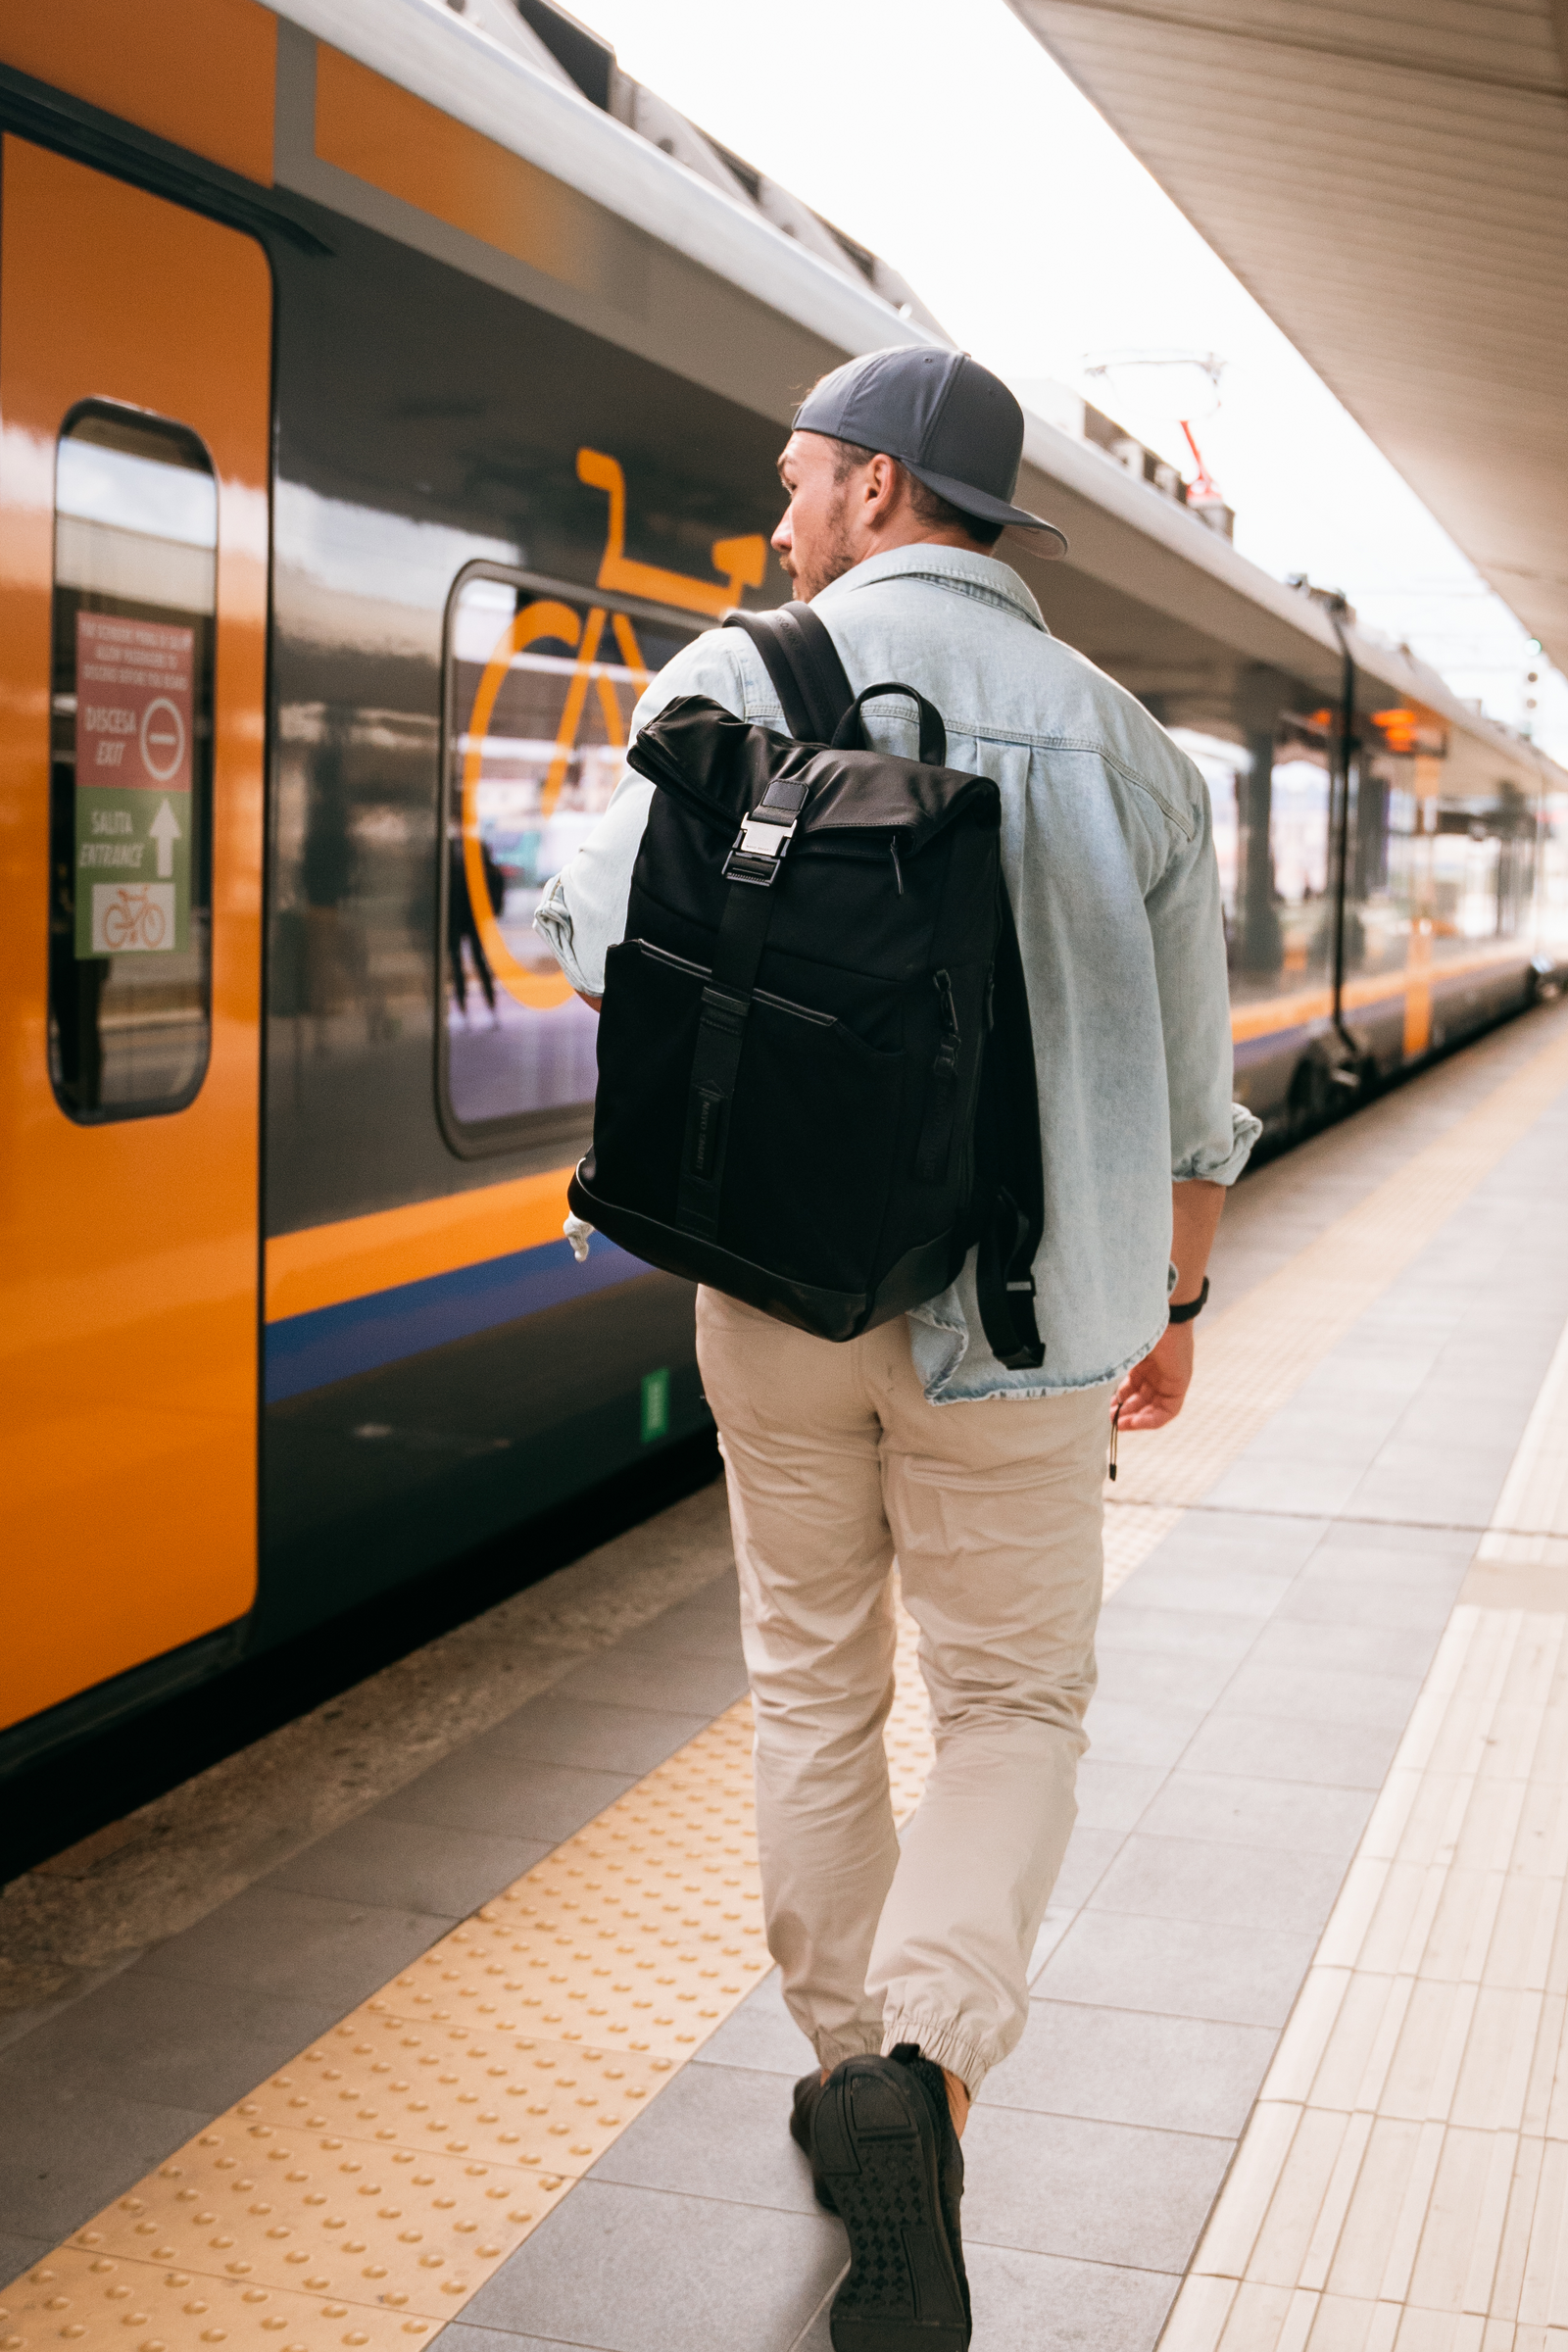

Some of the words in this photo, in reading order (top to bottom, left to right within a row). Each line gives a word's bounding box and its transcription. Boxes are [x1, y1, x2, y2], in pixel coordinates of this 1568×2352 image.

[85, 707, 136, 734] DISCESA
[97, 741, 125, 765] EXIT
[92, 811, 133, 835] SALITA
[79, 844, 144, 868] ENTRANCE
[700, 1101, 710, 1131] NAYO
[696, 1132, 707, 1170] SMART
